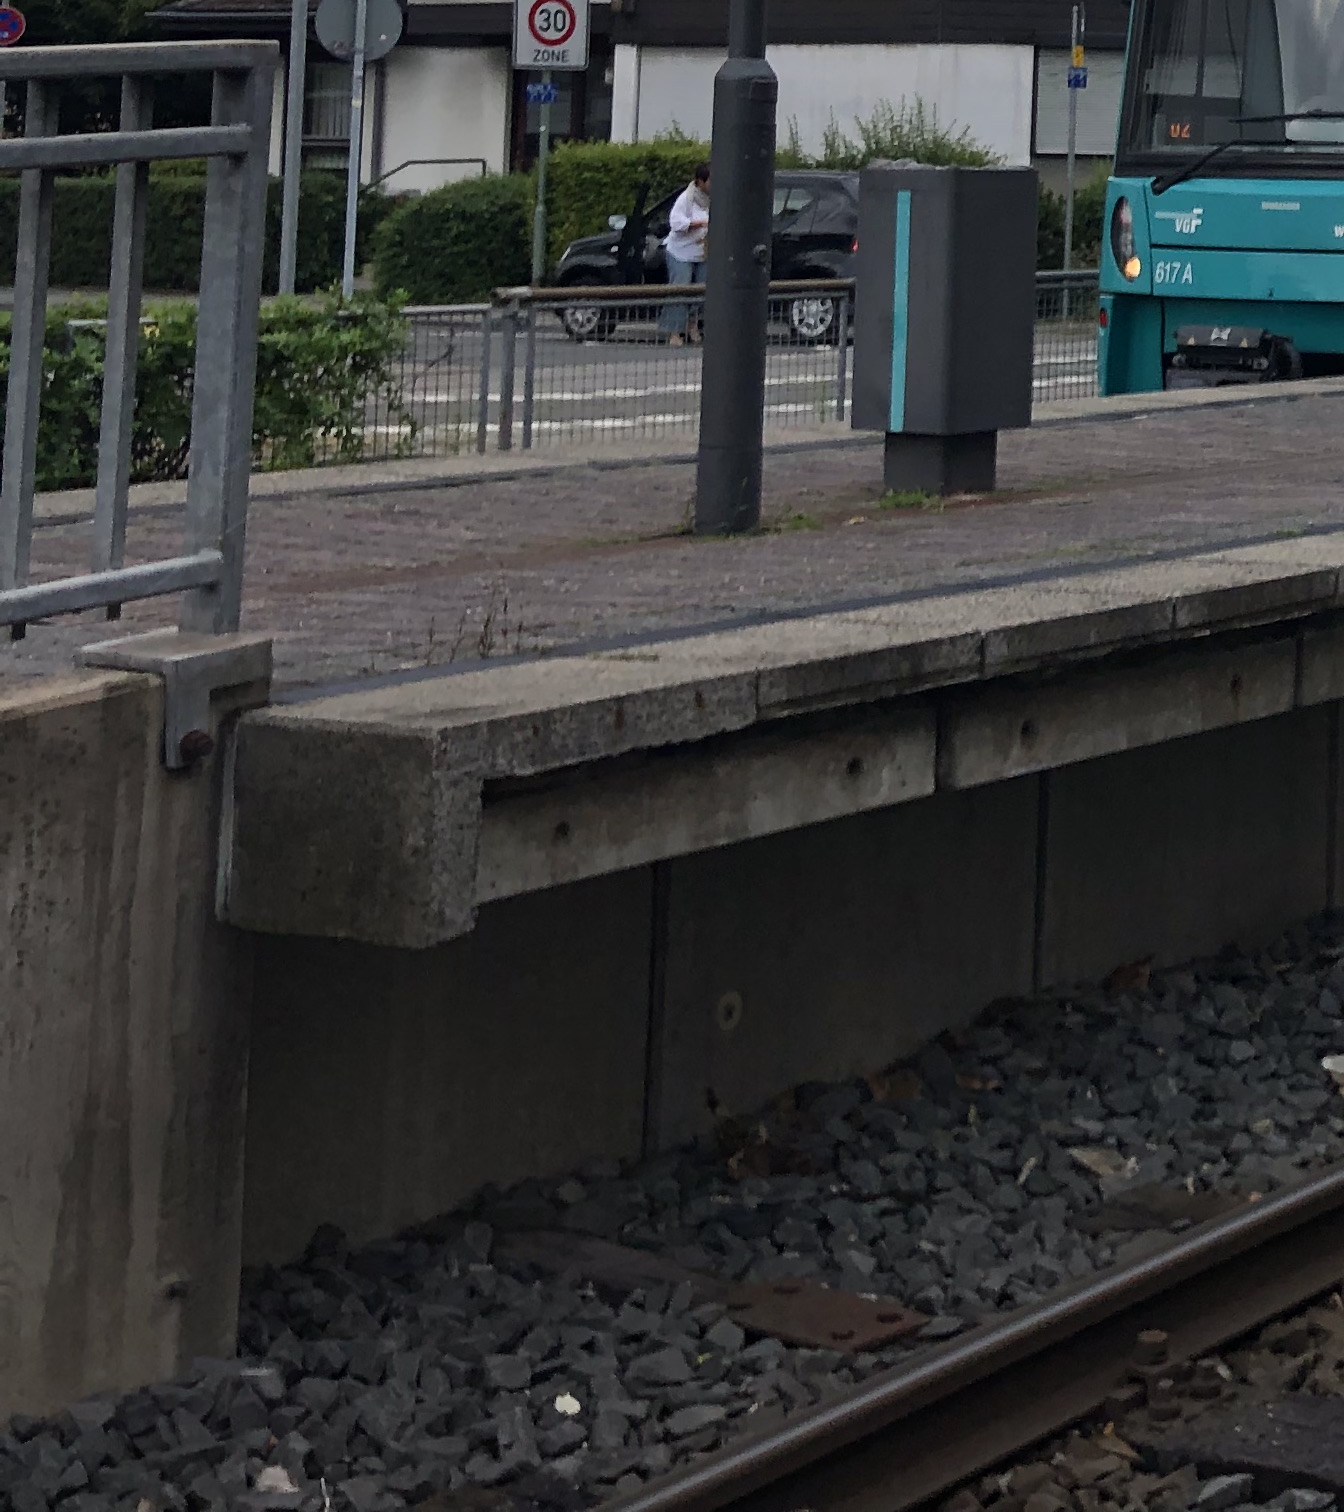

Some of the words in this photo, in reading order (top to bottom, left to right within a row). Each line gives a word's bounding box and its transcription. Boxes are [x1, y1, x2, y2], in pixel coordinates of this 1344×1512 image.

[538, 8, 566, 33] 30
[532, 49, 570, 64] ZONE
[1154, 261, 1180, 284] 617
[1181, 263, 1194, 284] A
